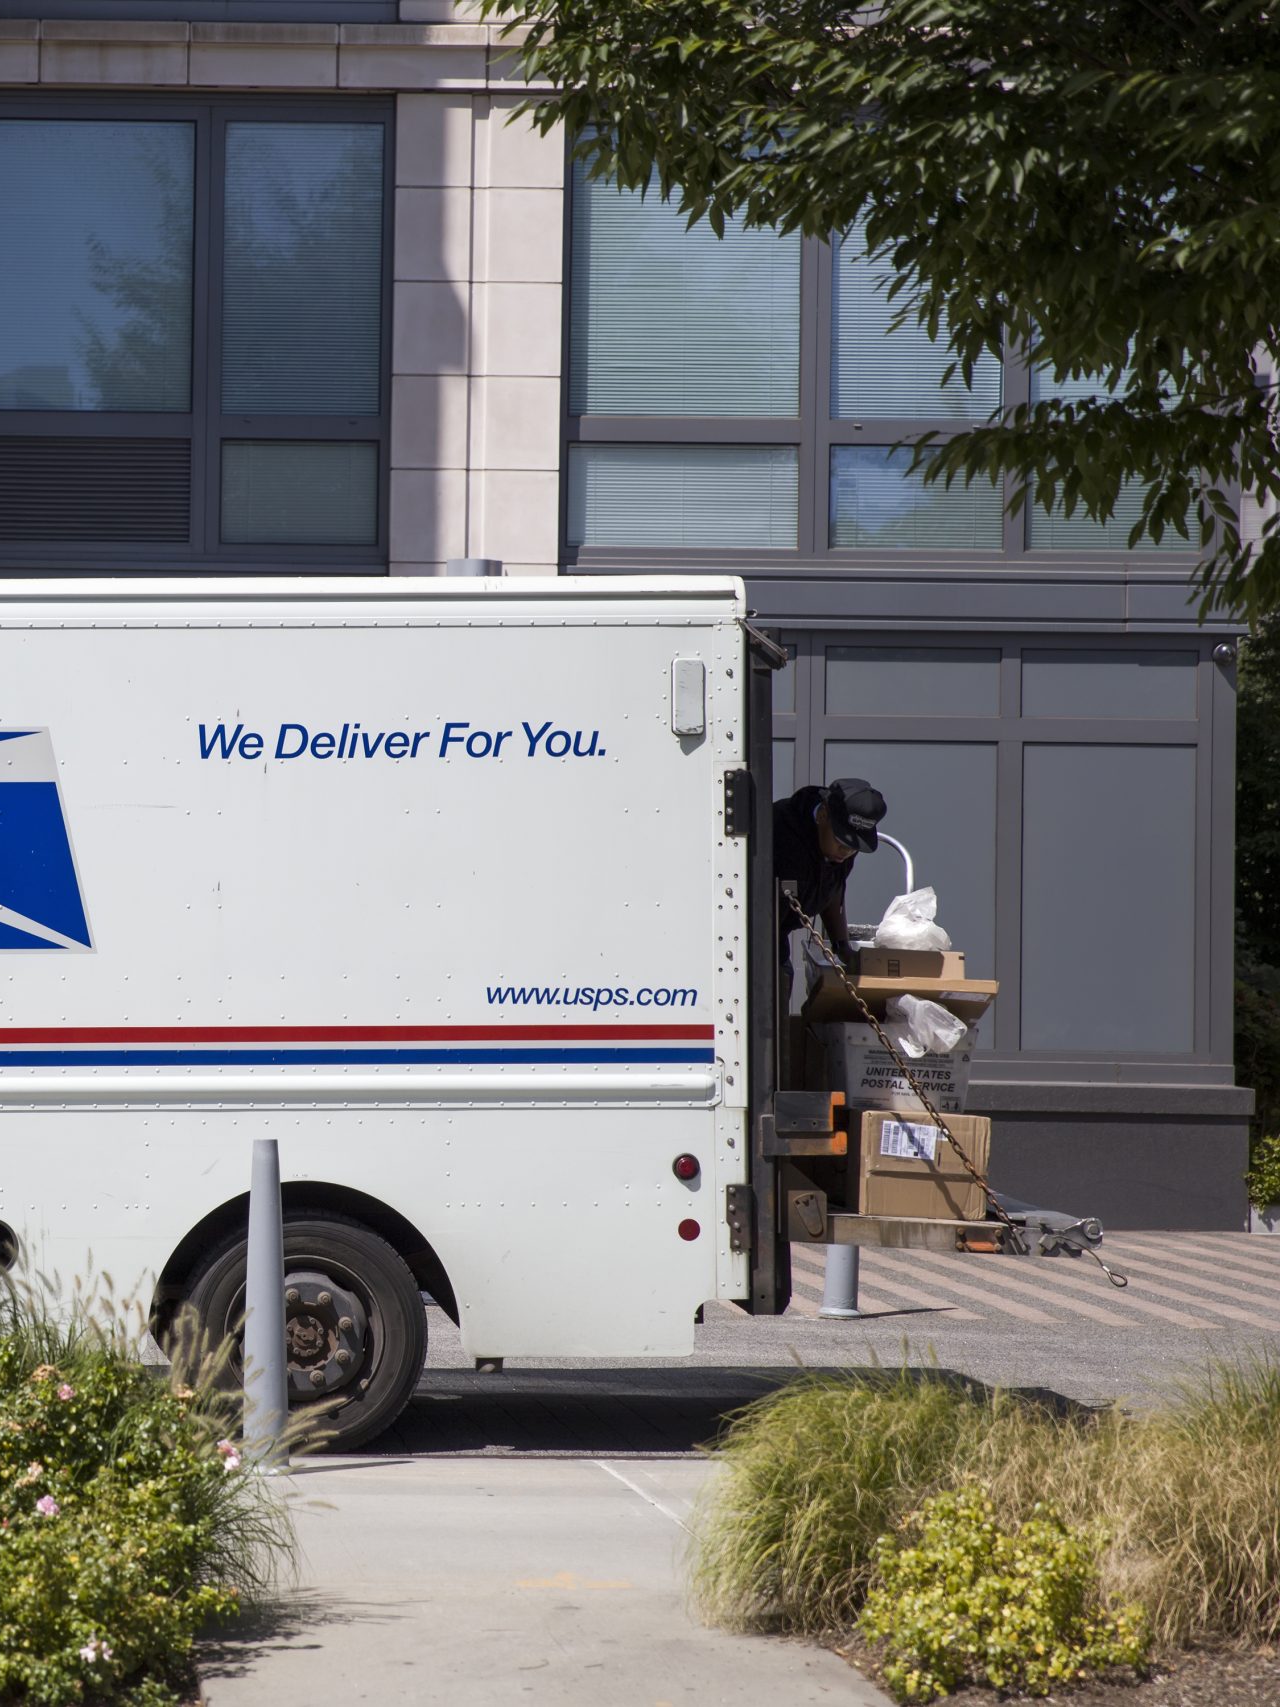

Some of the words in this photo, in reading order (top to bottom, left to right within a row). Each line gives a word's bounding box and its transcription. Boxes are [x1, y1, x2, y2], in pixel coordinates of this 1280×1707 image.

[198, 723, 264, 760] We
[275, 722, 430, 760] Deliver
[438, 721, 513, 759] For
[520, 720, 608, 758] You.
[486, 986, 698, 1012] www.usps.com
[866, 1066, 906, 1078] UNITED
[910, 1068, 952, 1080] STATES
[861, 1078, 905, 1090] POSTAL
